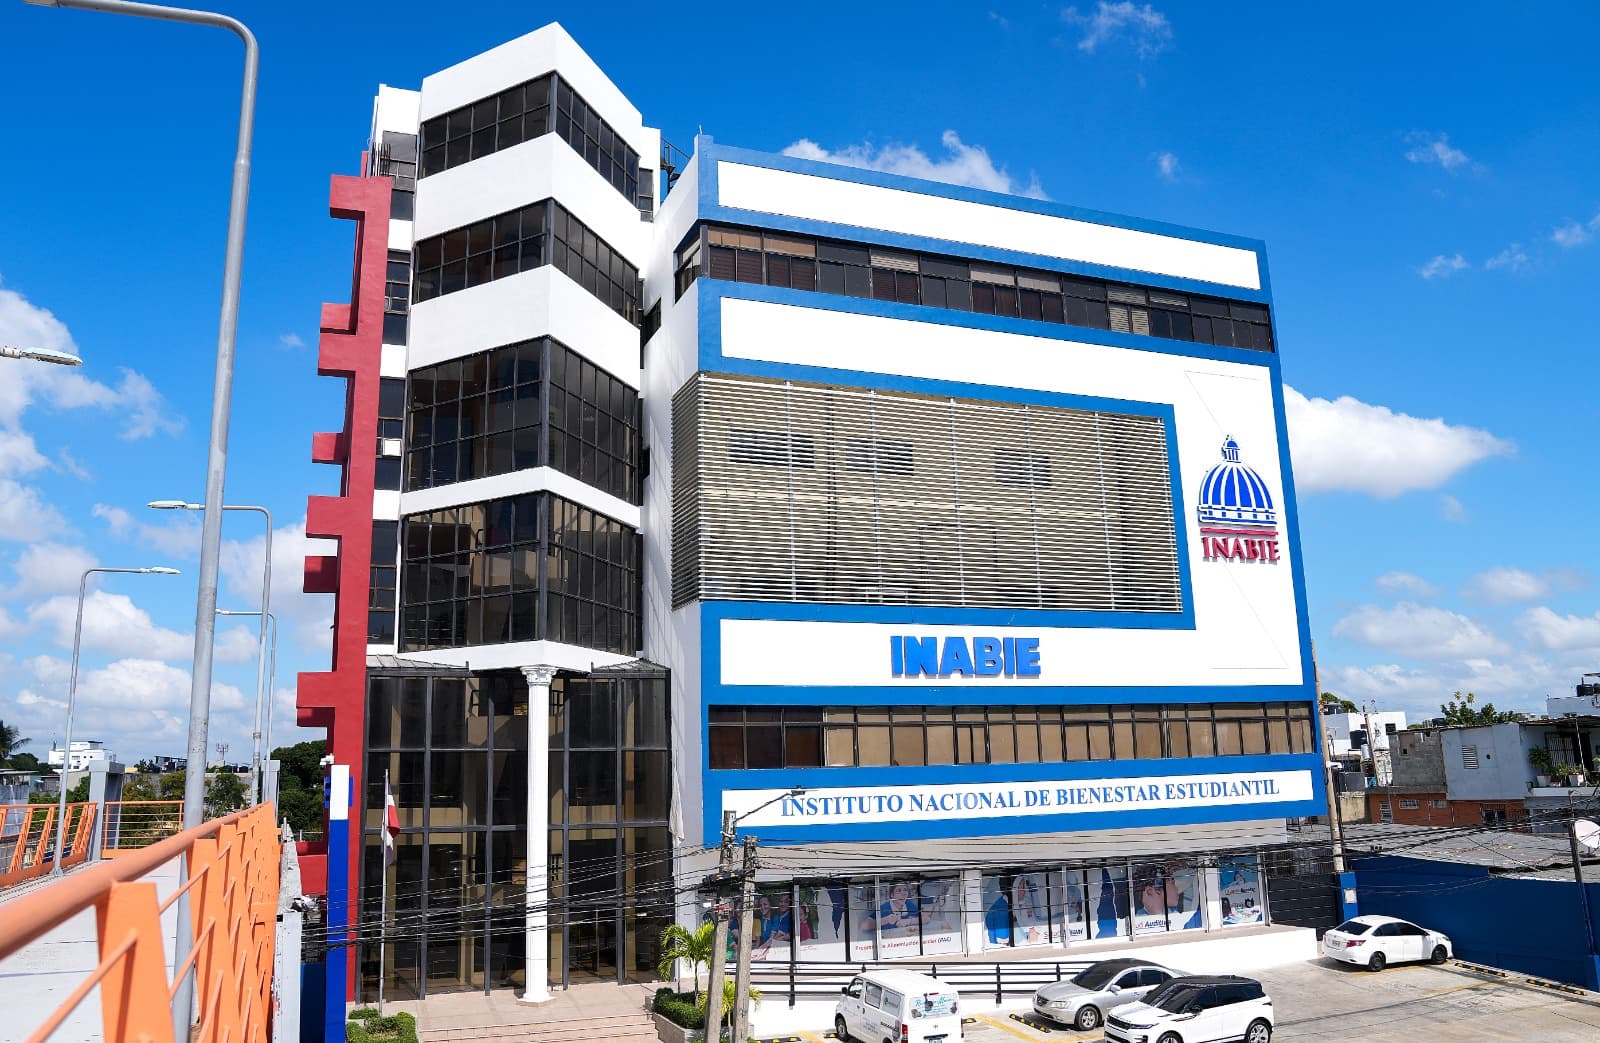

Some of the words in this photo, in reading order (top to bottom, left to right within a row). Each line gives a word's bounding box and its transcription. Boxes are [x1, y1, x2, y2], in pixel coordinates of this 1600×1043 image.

[1201, 537, 1280, 561] INABIE
[890, 635, 1041, 678] INABIE
[781, 794, 903, 817] INSTITUTO
[909, 790, 1020, 812] NACIONAL
[1024, 789, 1051, 807] DE
[1055, 784, 1161, 806] BIENESTAR
[1165, 778, 1280, 800] ESTUDIANTIL
